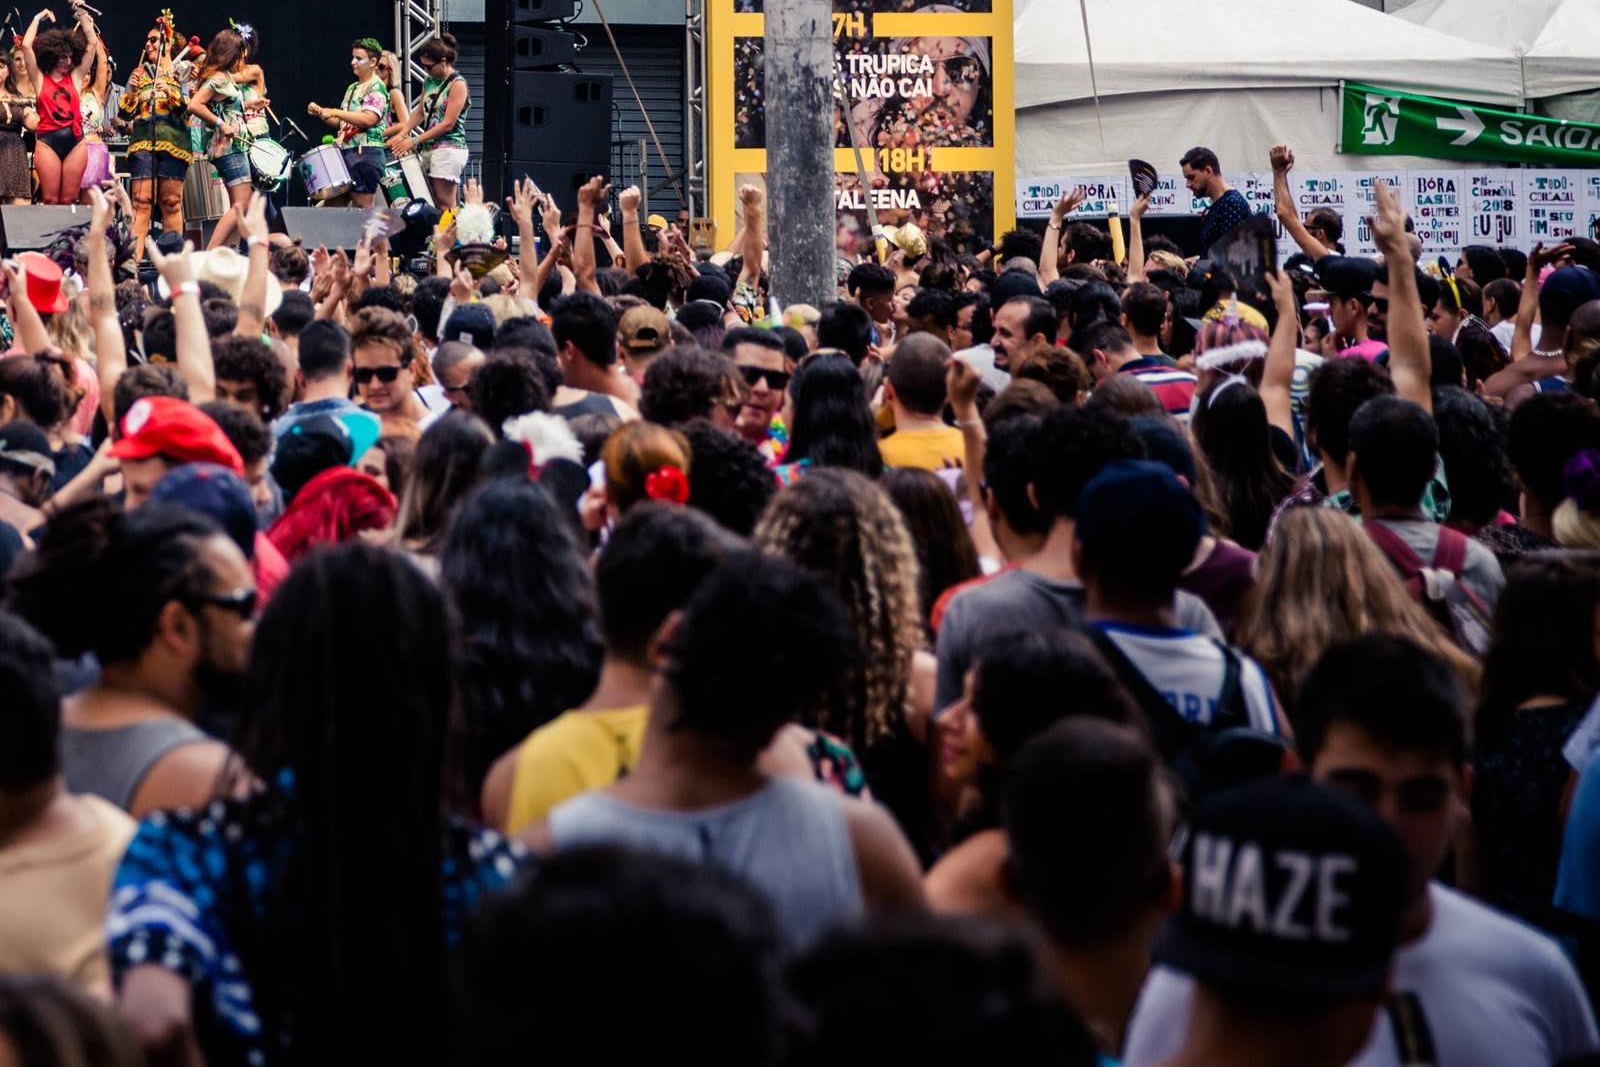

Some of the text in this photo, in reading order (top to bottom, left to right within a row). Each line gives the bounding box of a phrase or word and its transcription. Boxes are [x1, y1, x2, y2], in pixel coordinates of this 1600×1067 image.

[832, 13, 864, 37] 7H
[846, 54, 934, 74] TRUPICA
[851, 74, 895, 98] NÃO
[899, 78, 933, 98] CAI
[880, 148, 925, 173] 18H
[1483, 200, 1513, 211] 2018
[1192, 833, 1357, 942] HAZE
